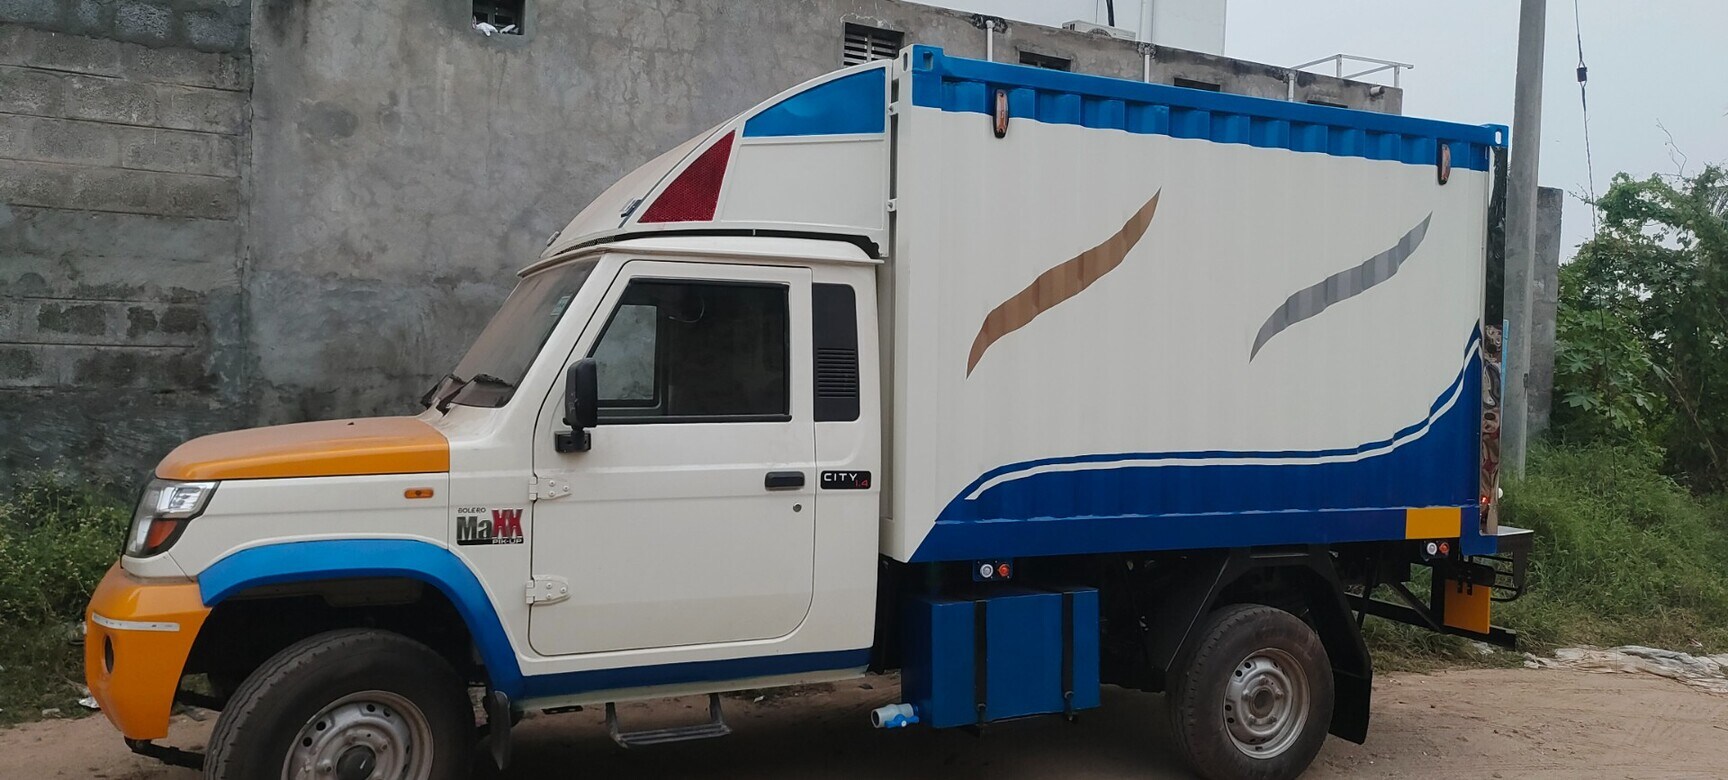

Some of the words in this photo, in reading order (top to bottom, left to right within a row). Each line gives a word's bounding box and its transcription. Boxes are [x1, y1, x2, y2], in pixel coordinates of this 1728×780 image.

[823, 473, 858, 482] CITY
[855, 480, 869, 488] 1.4
[456, 508, 524, 540] MaXX
